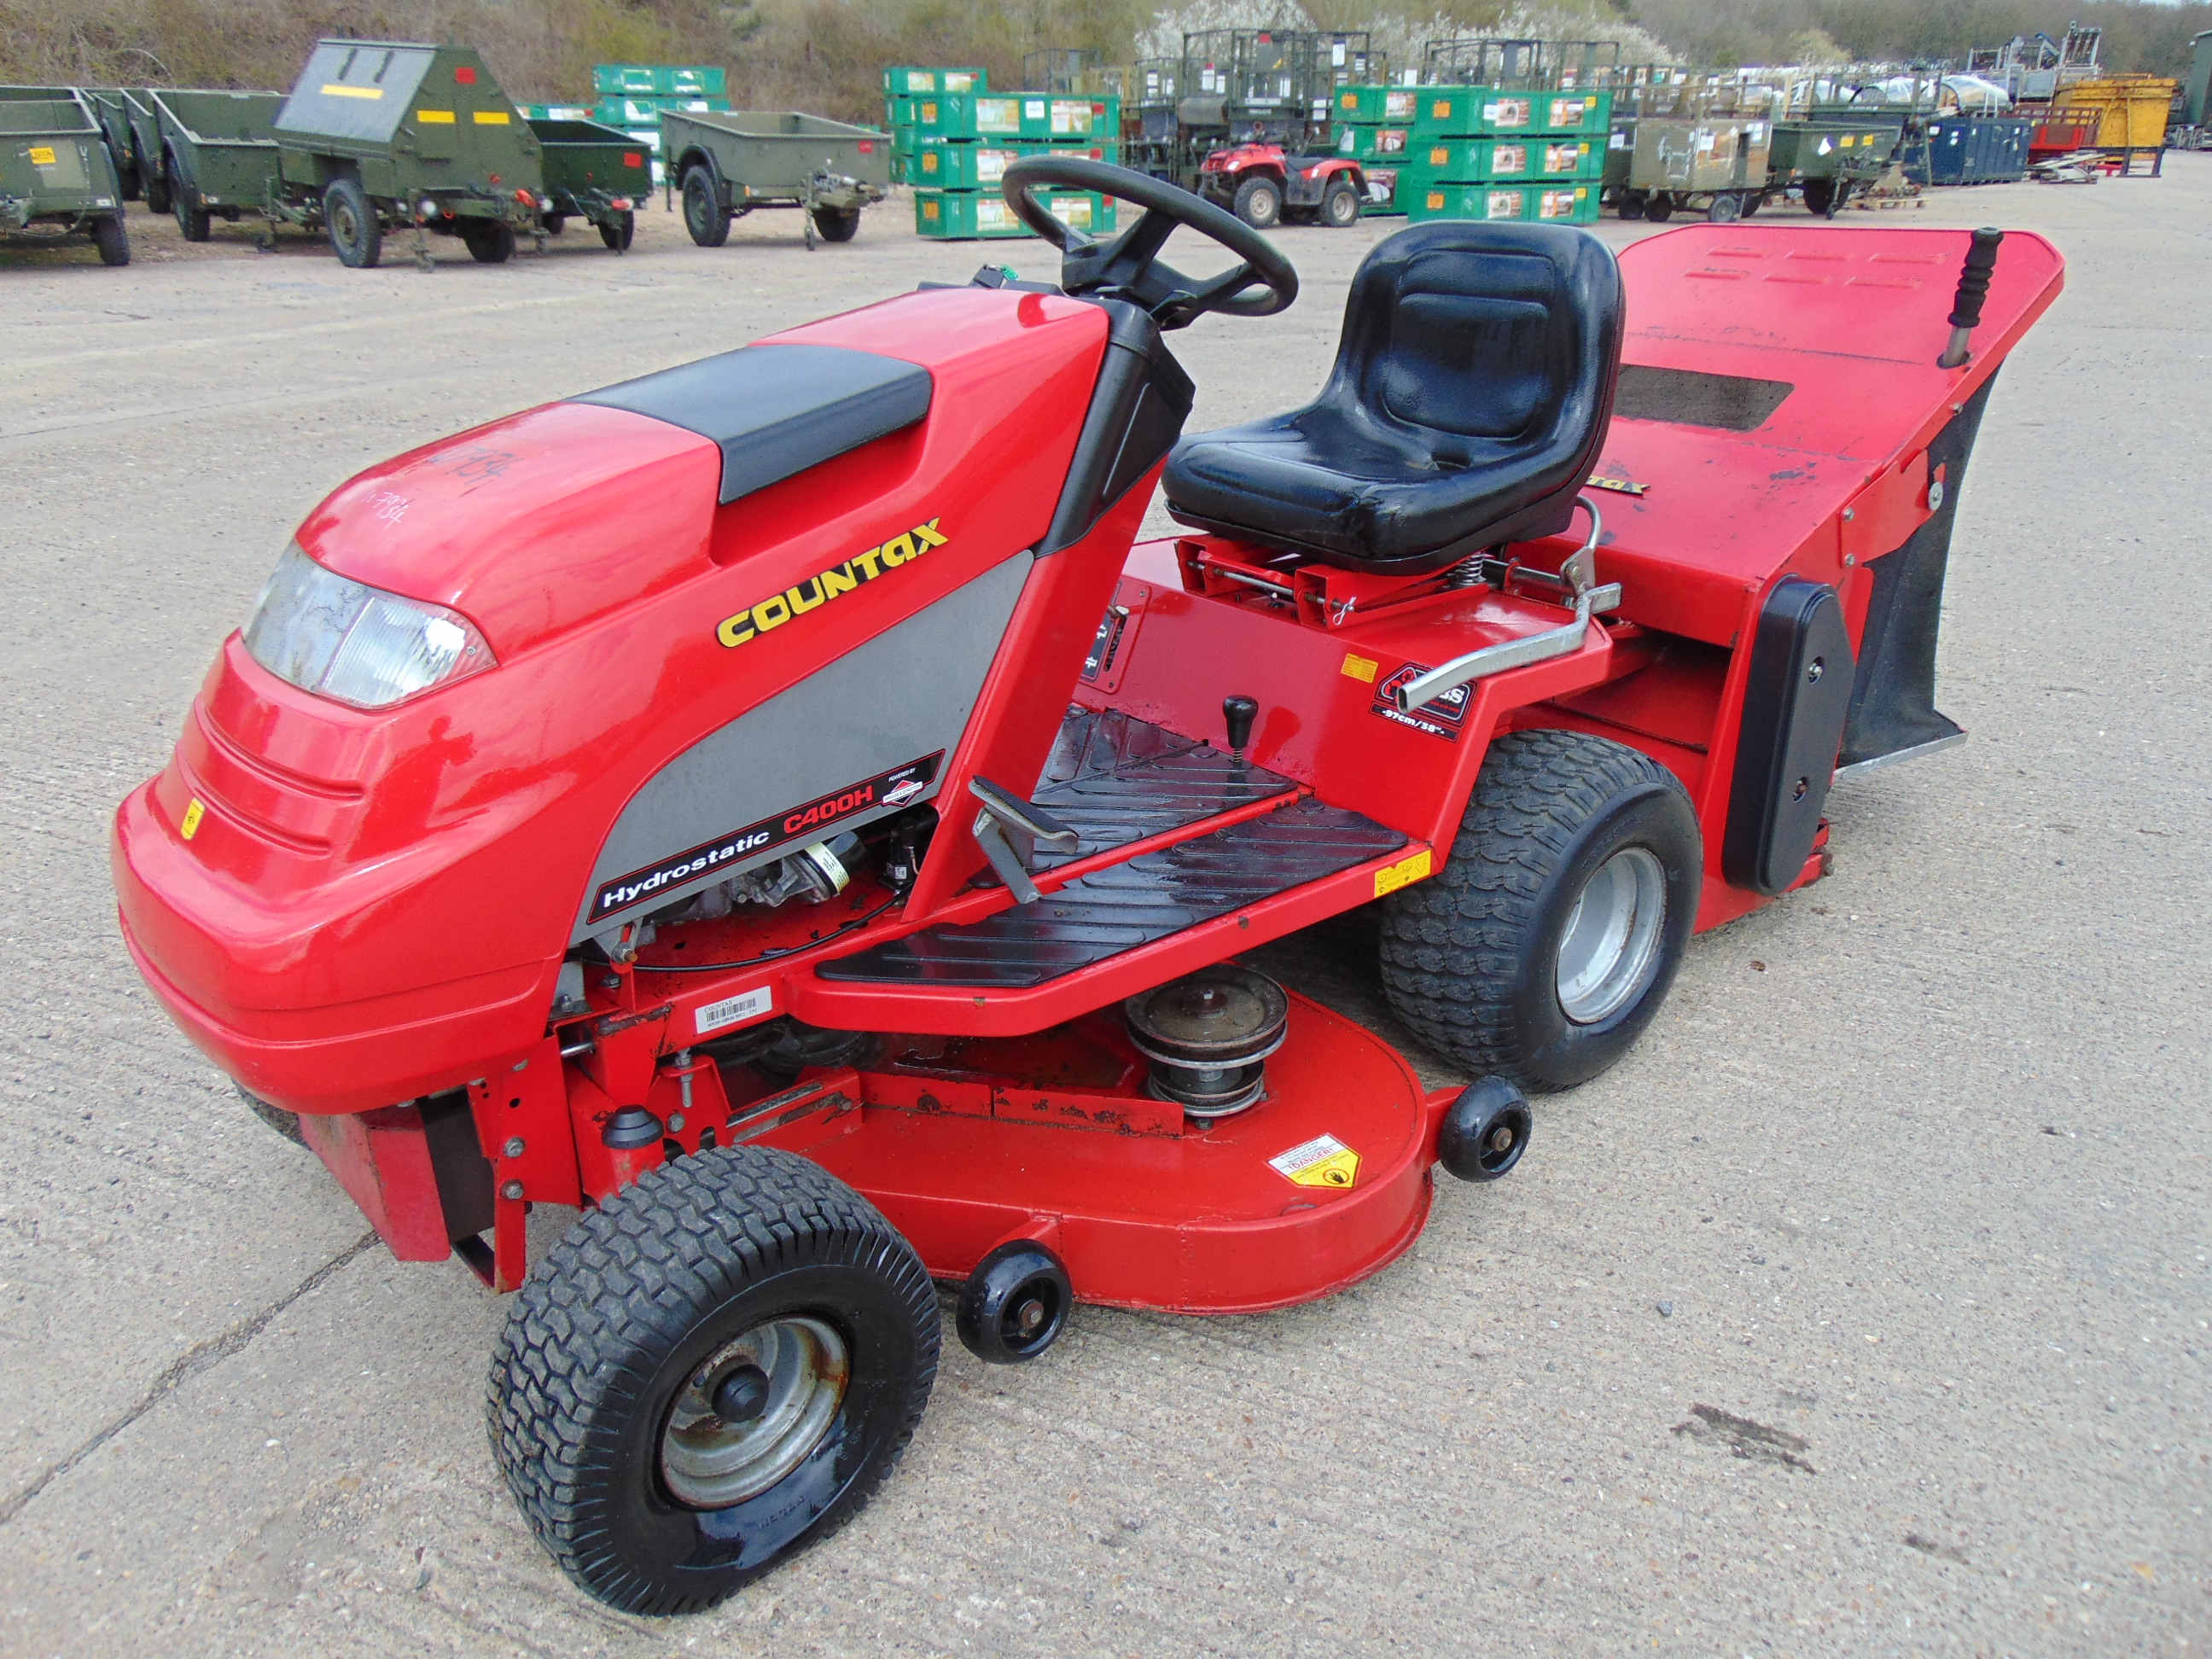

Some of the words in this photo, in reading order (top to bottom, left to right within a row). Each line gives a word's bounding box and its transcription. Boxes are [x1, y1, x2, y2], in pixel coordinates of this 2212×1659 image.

[718, 516, 949, 648] COUNTAX
[888, 770, 909, 782] POWERED
[783, 785, 874, 834] C400H
[602, 831, 770, 909] Hydrostatic
[704, 999, 733, 1013] COUNTAX
